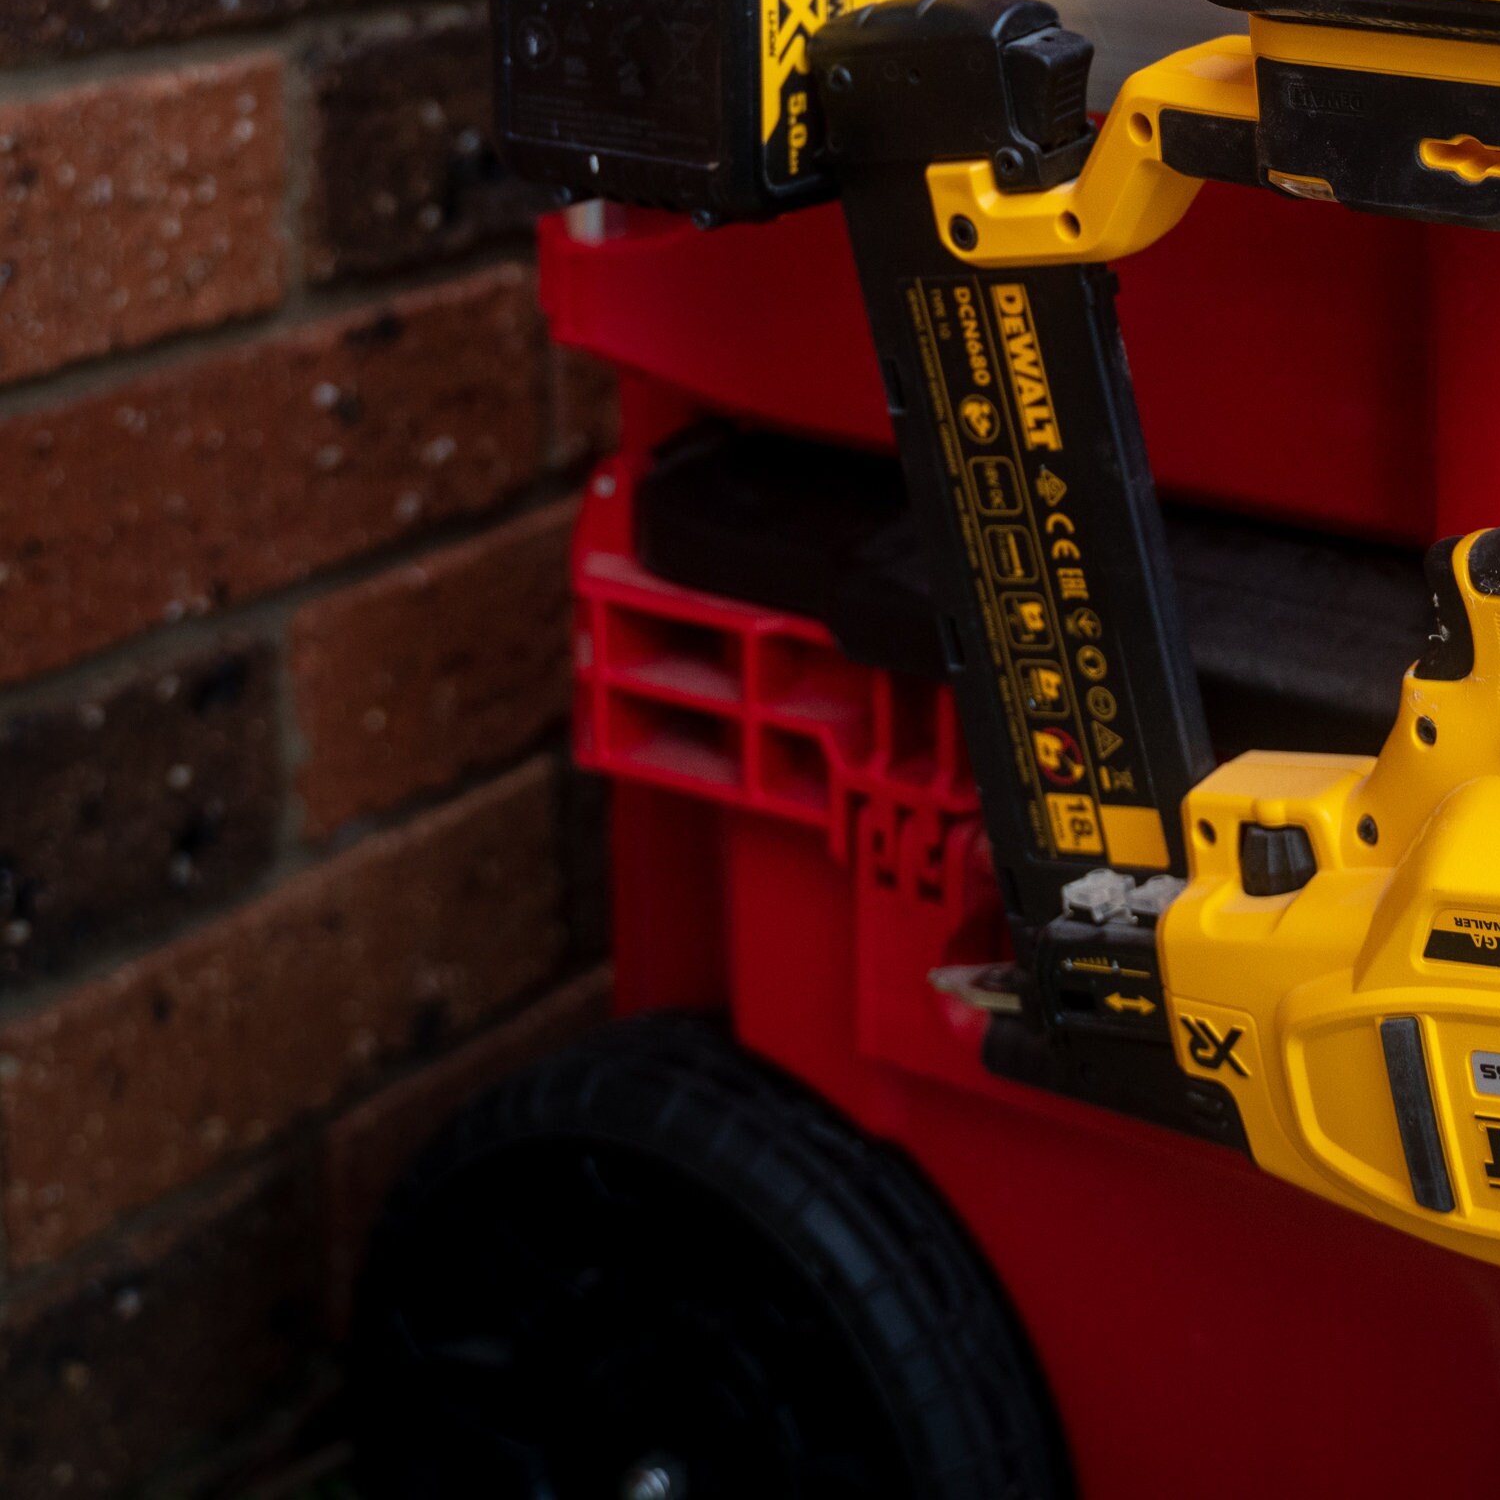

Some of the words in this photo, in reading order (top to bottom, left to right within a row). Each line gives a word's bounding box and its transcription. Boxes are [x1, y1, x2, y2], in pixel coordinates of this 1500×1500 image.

[954, 286, 991, 387] DCN680
[993, 283, 1062, 451] DEWALT
[1065, 797, 1093, 837] 18
[1470, 933, 1498, 949] GA
[1179, 1014, 1249, 1078] XR
